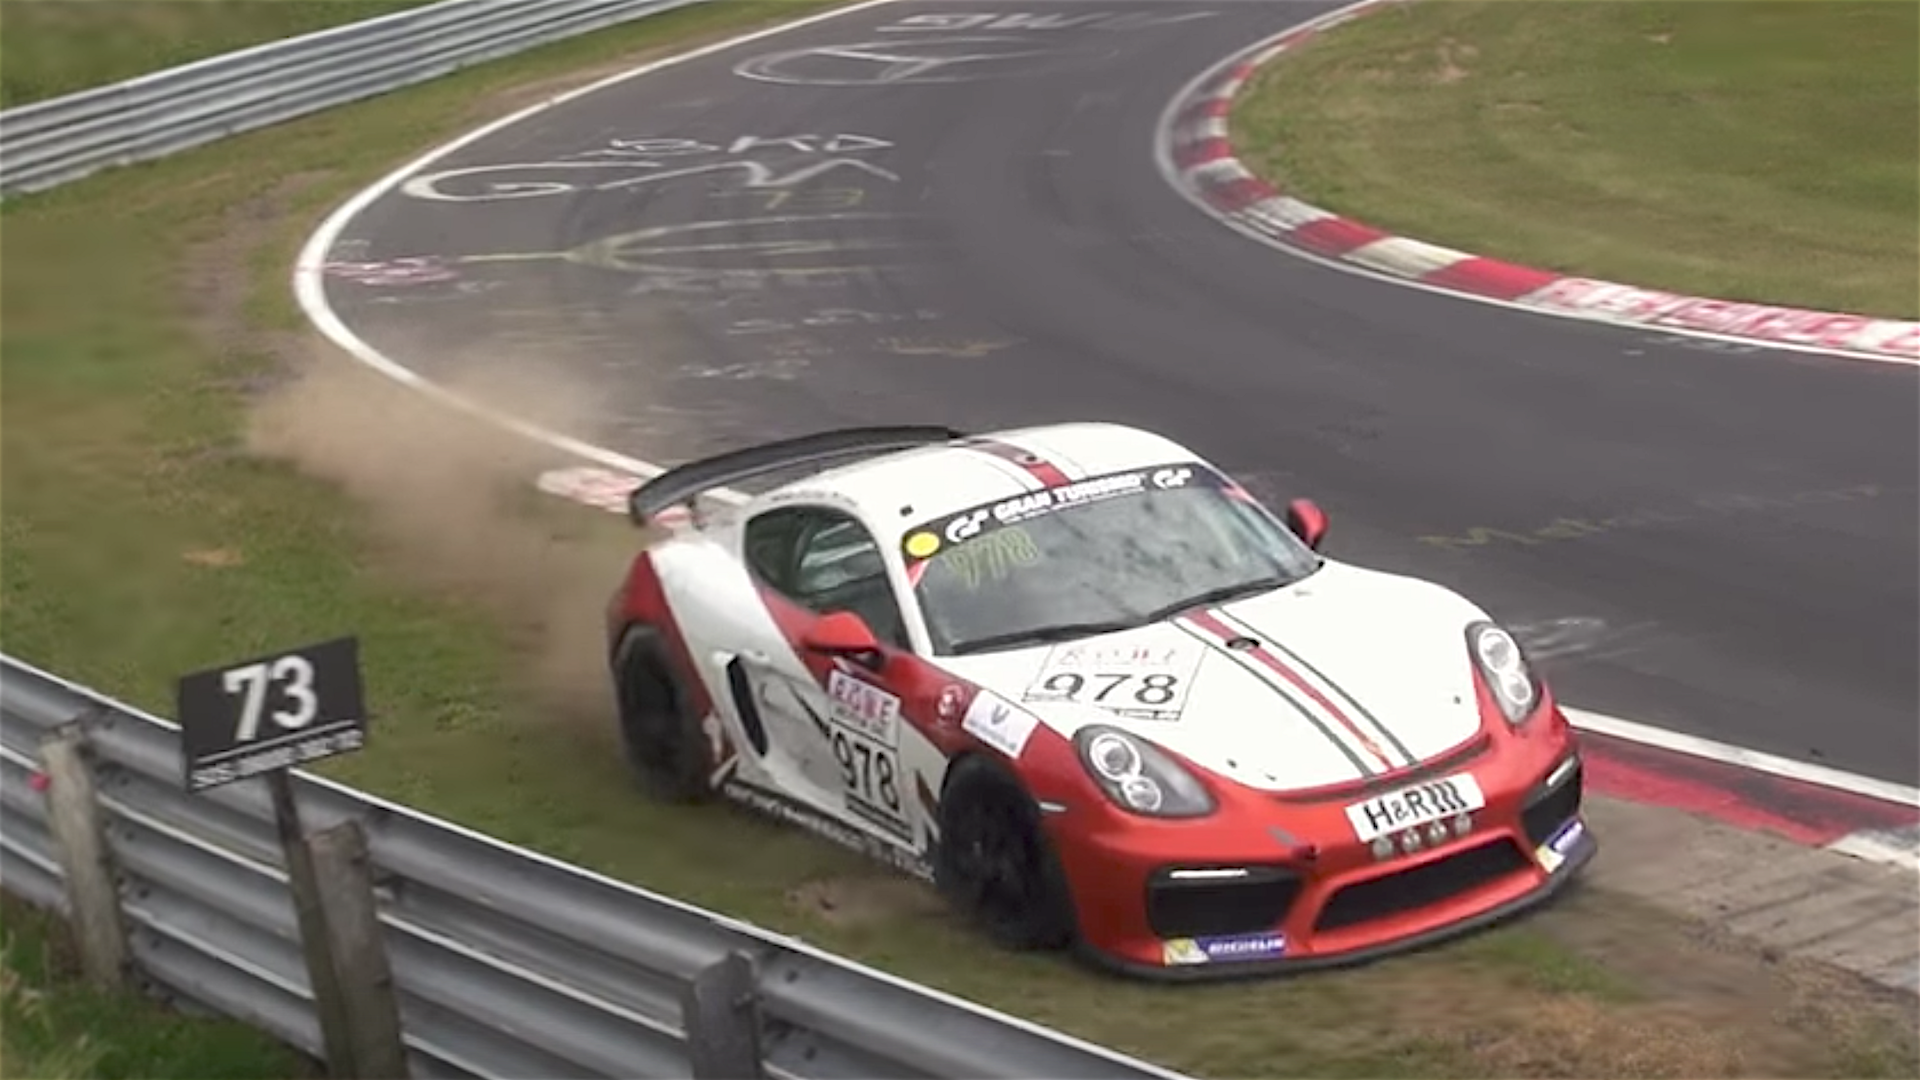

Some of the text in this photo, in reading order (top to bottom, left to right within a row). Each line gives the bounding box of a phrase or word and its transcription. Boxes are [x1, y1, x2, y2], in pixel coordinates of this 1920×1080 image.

[993, 490, 1051, 520] GRAN
[1053, 475, 1141, 503] TURISMO
[223, 655, 318, 741] 73
[1043, 673, 1178, 705] 978
[832, 730, 900, 811] 978
